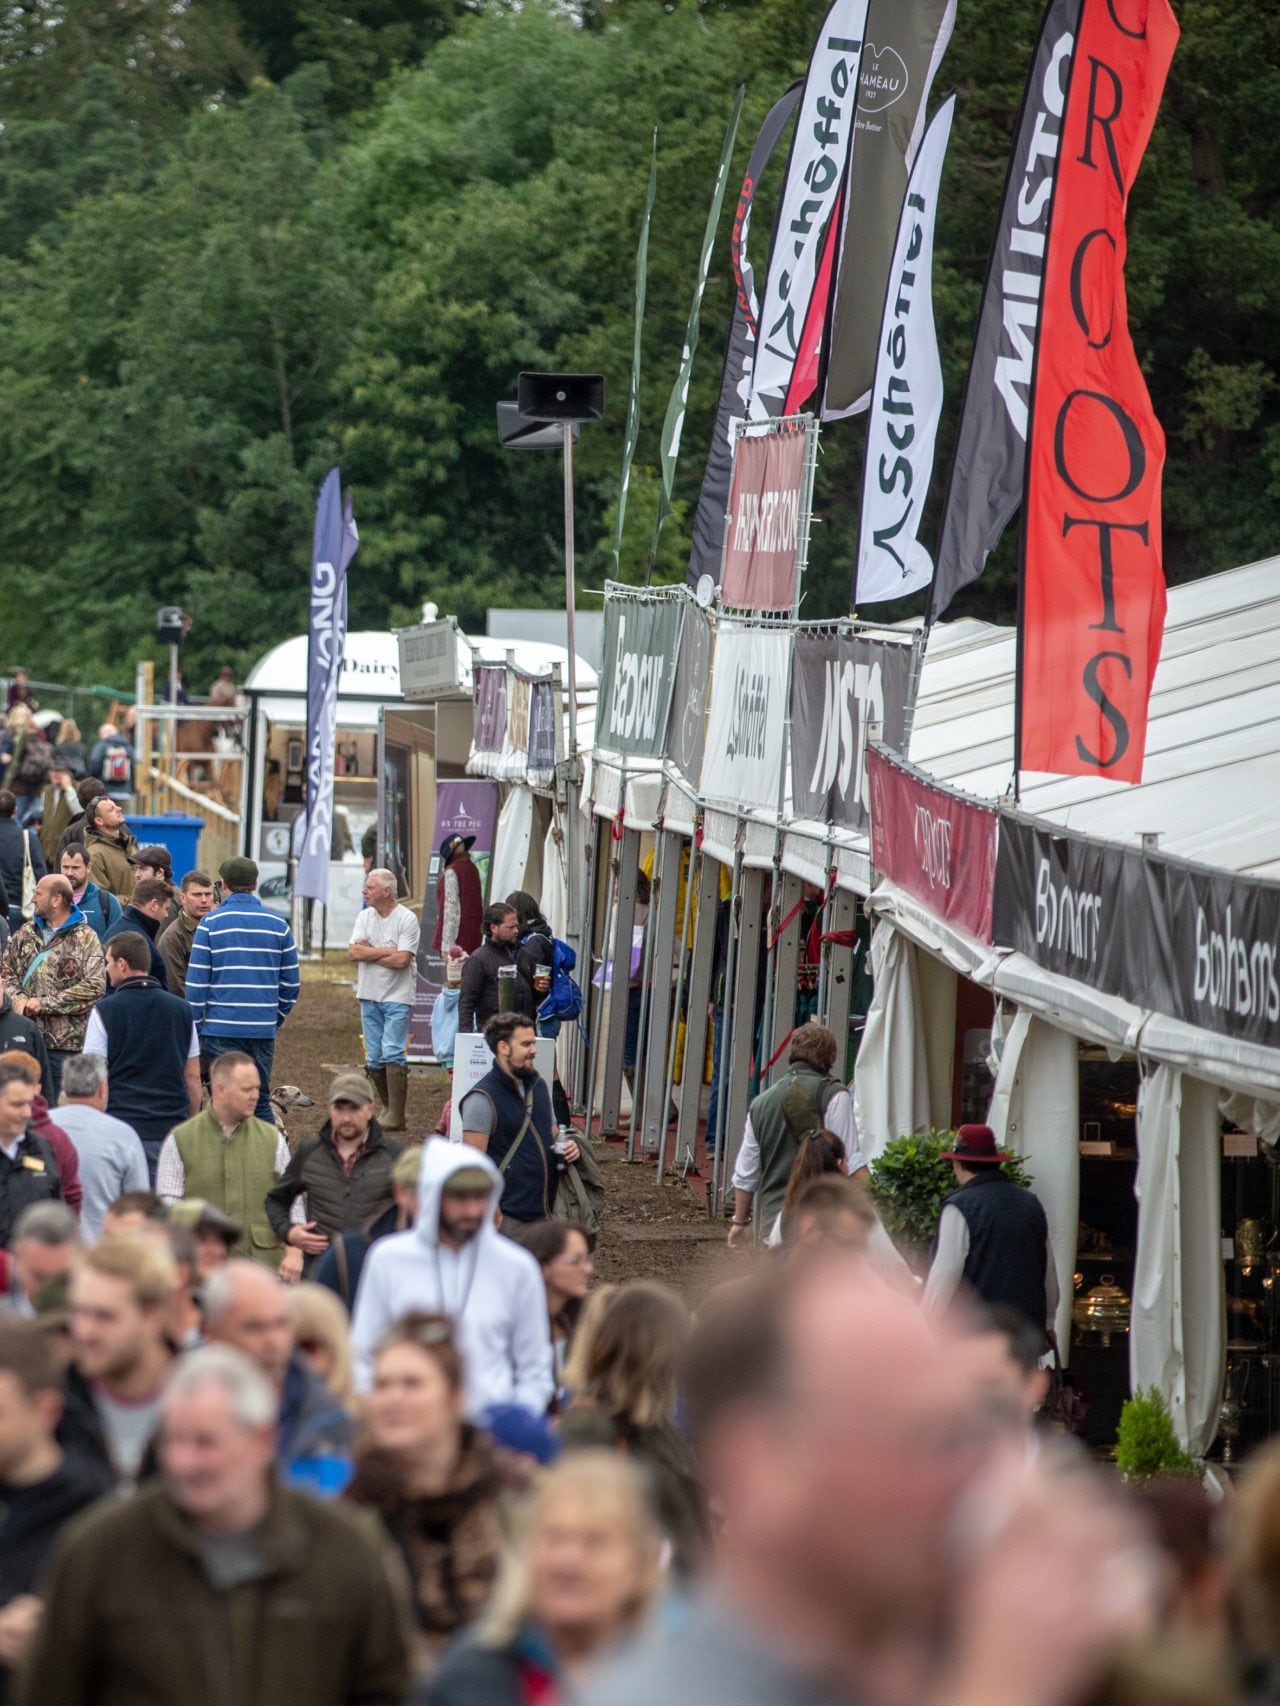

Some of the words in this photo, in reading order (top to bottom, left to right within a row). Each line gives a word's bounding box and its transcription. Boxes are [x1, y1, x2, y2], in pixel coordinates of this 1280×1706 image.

[872, 63, 879, 71] LE
[860, 72, 900, 91] HAMEAU
[730, 172, 757, 333] INEERED
[343, 658, 400, 684] Dairy
[610, 615, 663, 740] Baour
[453, 820, 466, 828] THE
[1194, 904, 1280, 1023] Bonhams
